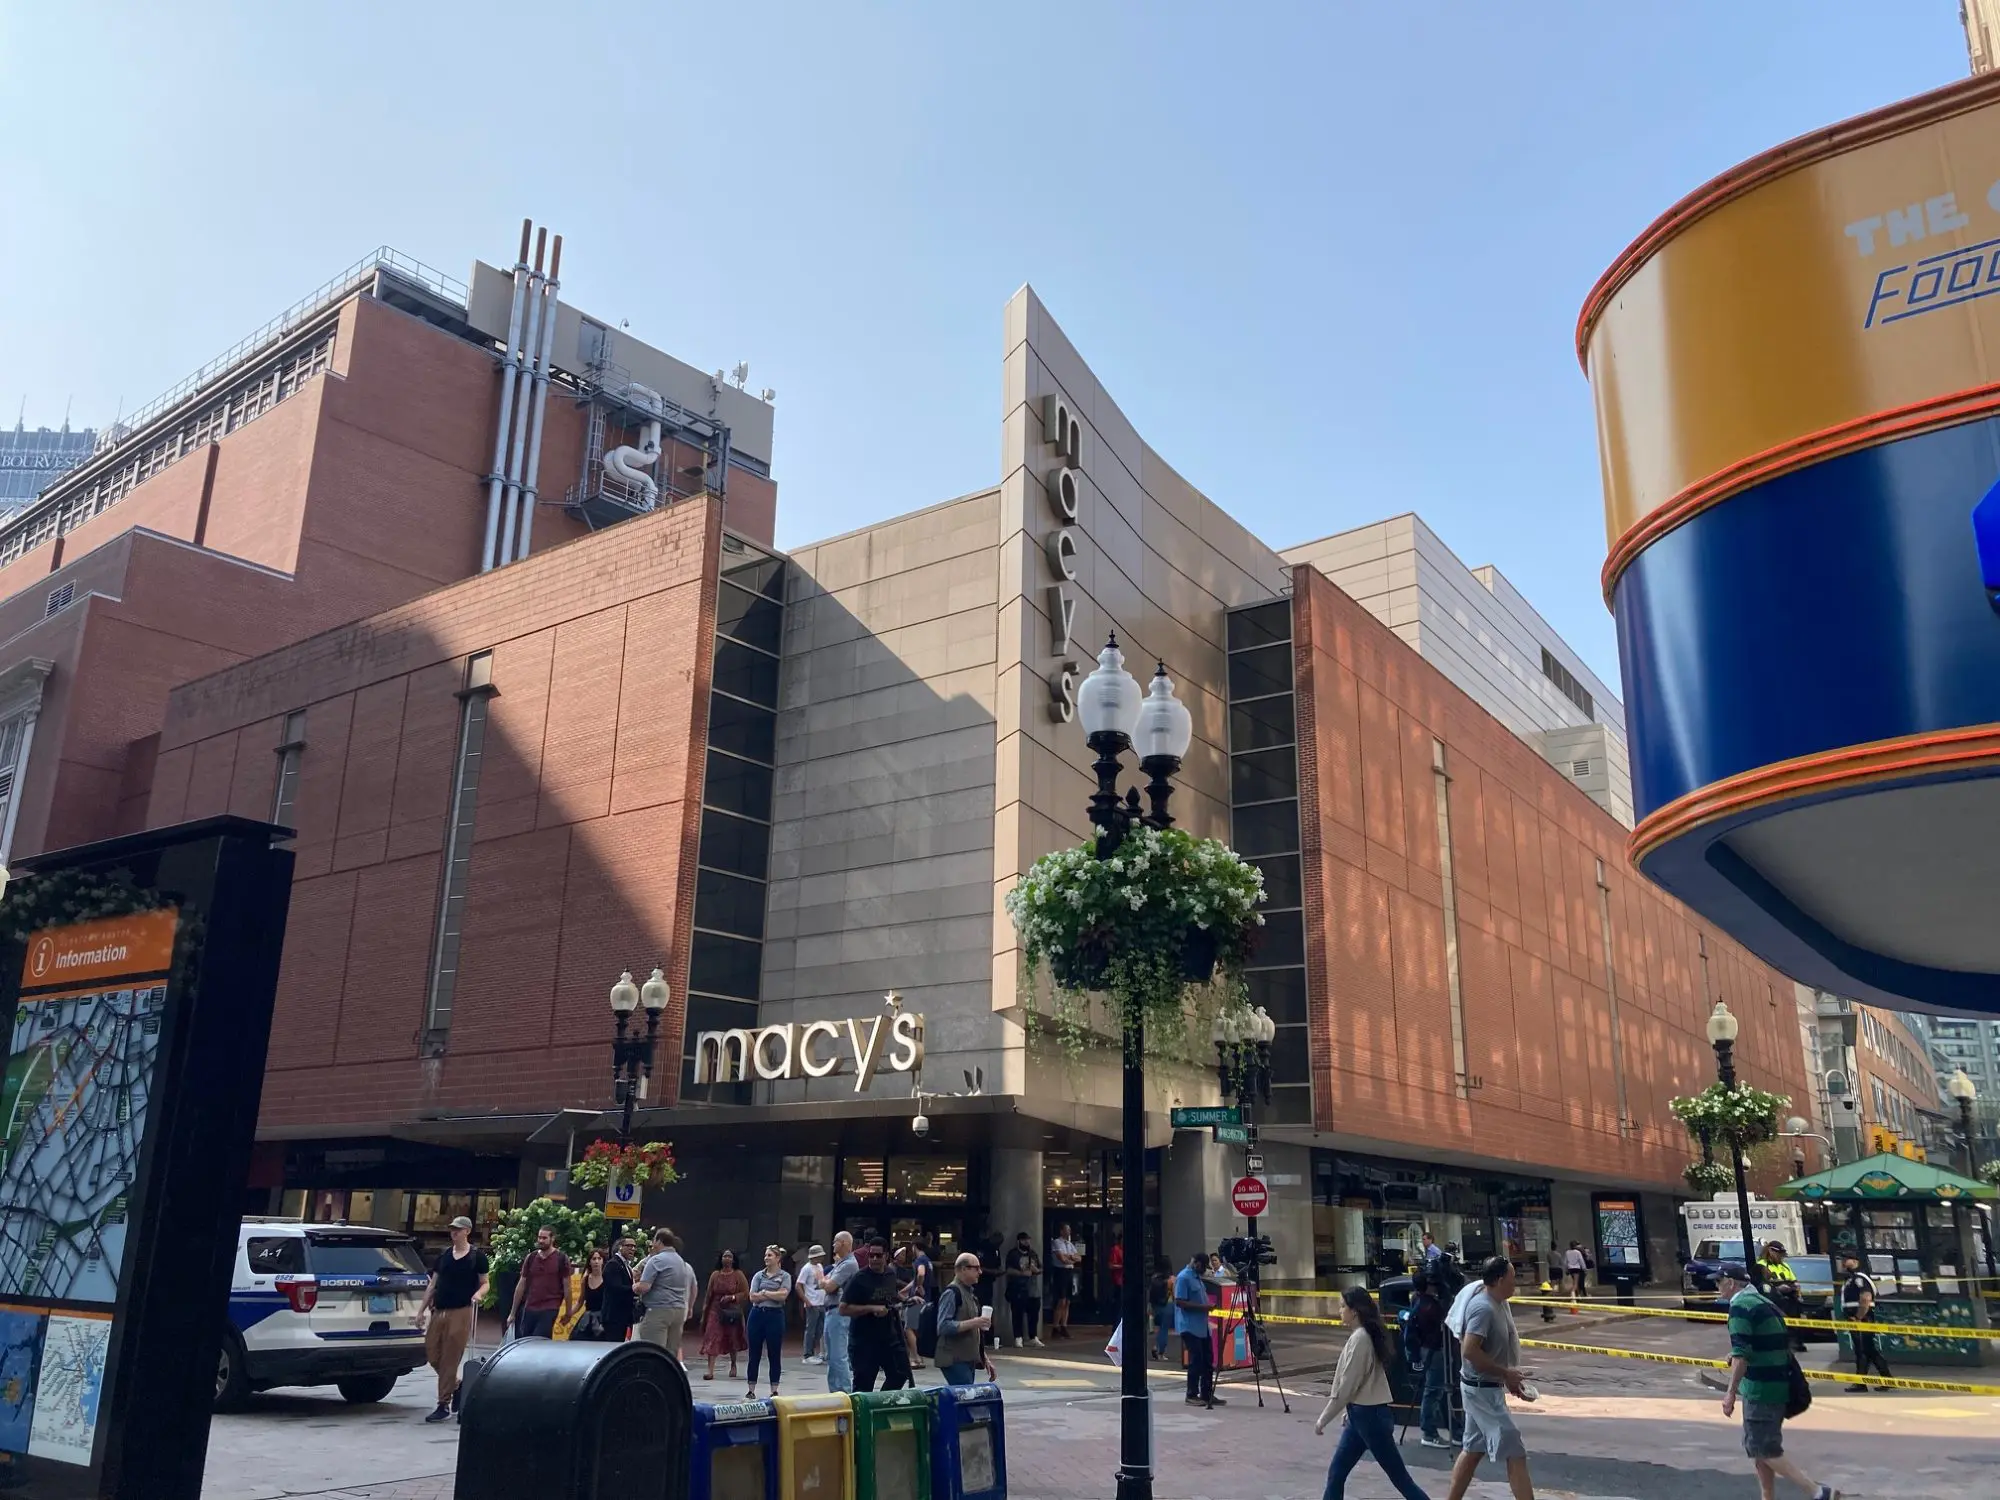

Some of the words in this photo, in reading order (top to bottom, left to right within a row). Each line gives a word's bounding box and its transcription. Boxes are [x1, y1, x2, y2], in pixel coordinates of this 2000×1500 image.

[1844, 192, 1969, 257] THE
[56, 944, 127, 968] Information
[1191, 1111, 1228, 1121] SUMMER
[320, 1279, 365, 1287] BOSTON
[715, 1404, 744, 1416] VISION
[745, 1402, 766, 1413] TIMES
